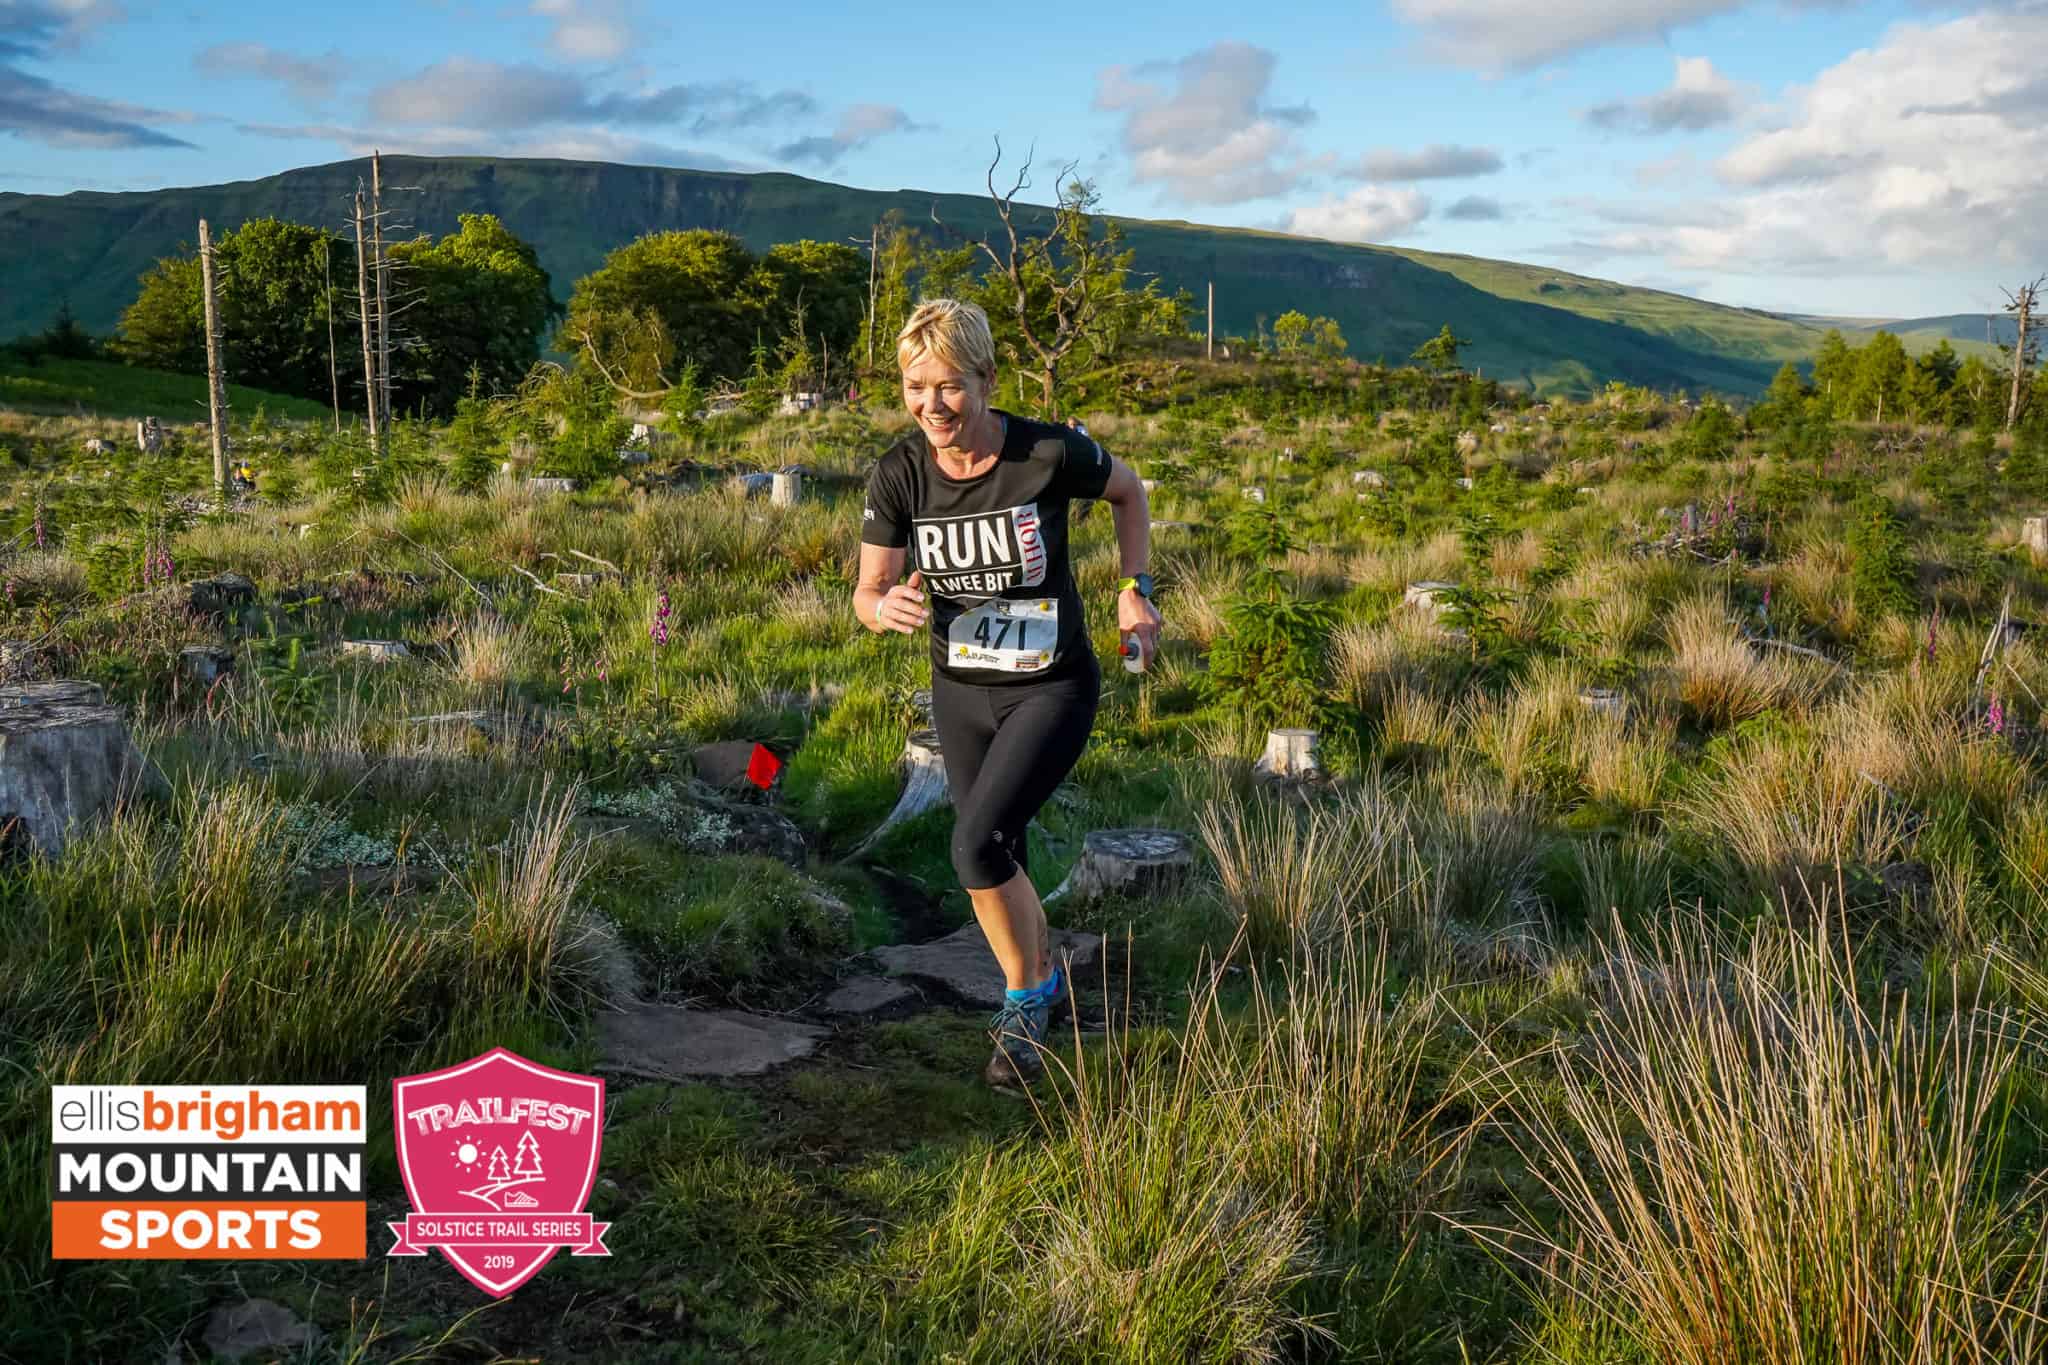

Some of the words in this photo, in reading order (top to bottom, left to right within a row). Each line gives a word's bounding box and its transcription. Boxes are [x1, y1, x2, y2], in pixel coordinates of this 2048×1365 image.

[917, 517, 1012, 569] RUN
[930, 578, 944, 592] A
[942, 574, 983, 591] WEE
[985, 572, 1013, 592] BIT
[974, 616, 1026, 651] 471
